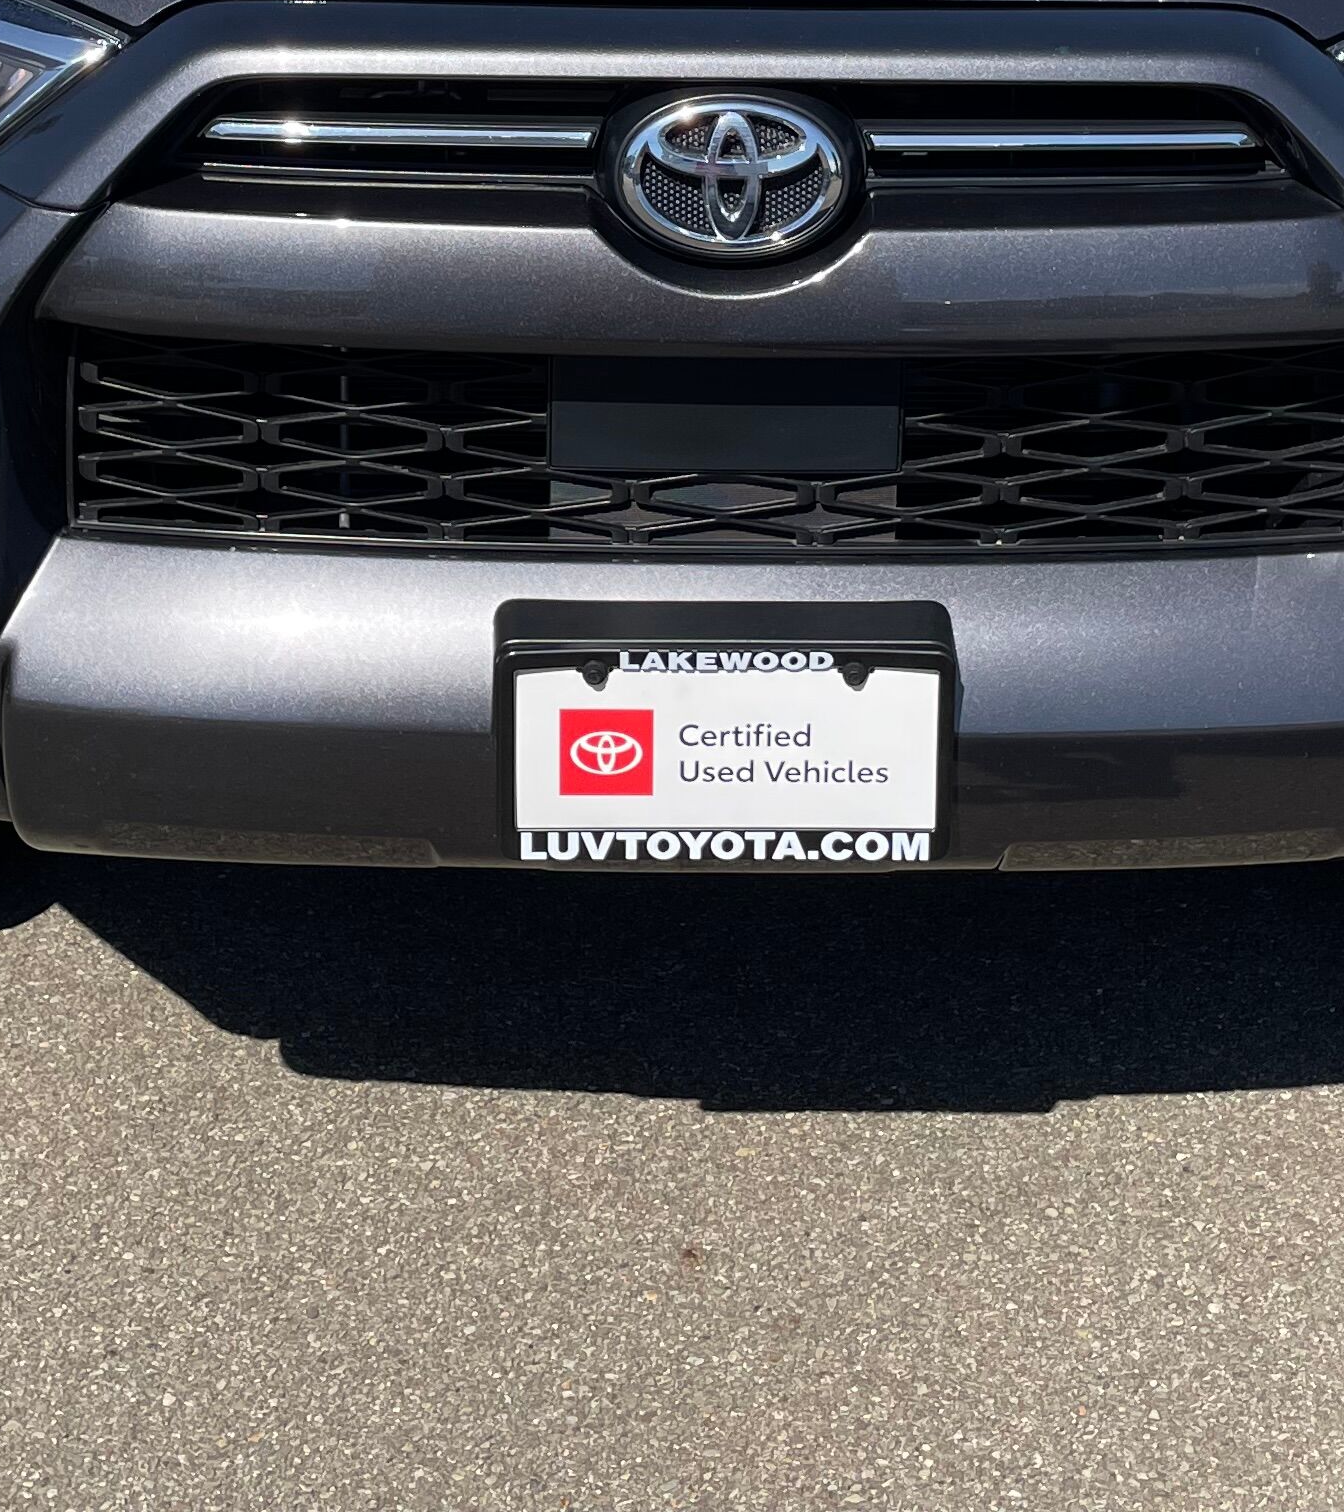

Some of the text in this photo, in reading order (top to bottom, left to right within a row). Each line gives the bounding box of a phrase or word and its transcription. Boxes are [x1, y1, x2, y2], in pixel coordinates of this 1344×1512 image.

[619, 650, 834, 672] LAKEWOOD
[678, 723, 812, 748] Certified
[678, 759, 889, 784] Used Vehicles
[519, 831, 931, 862] LUVTOYOTA.COM
